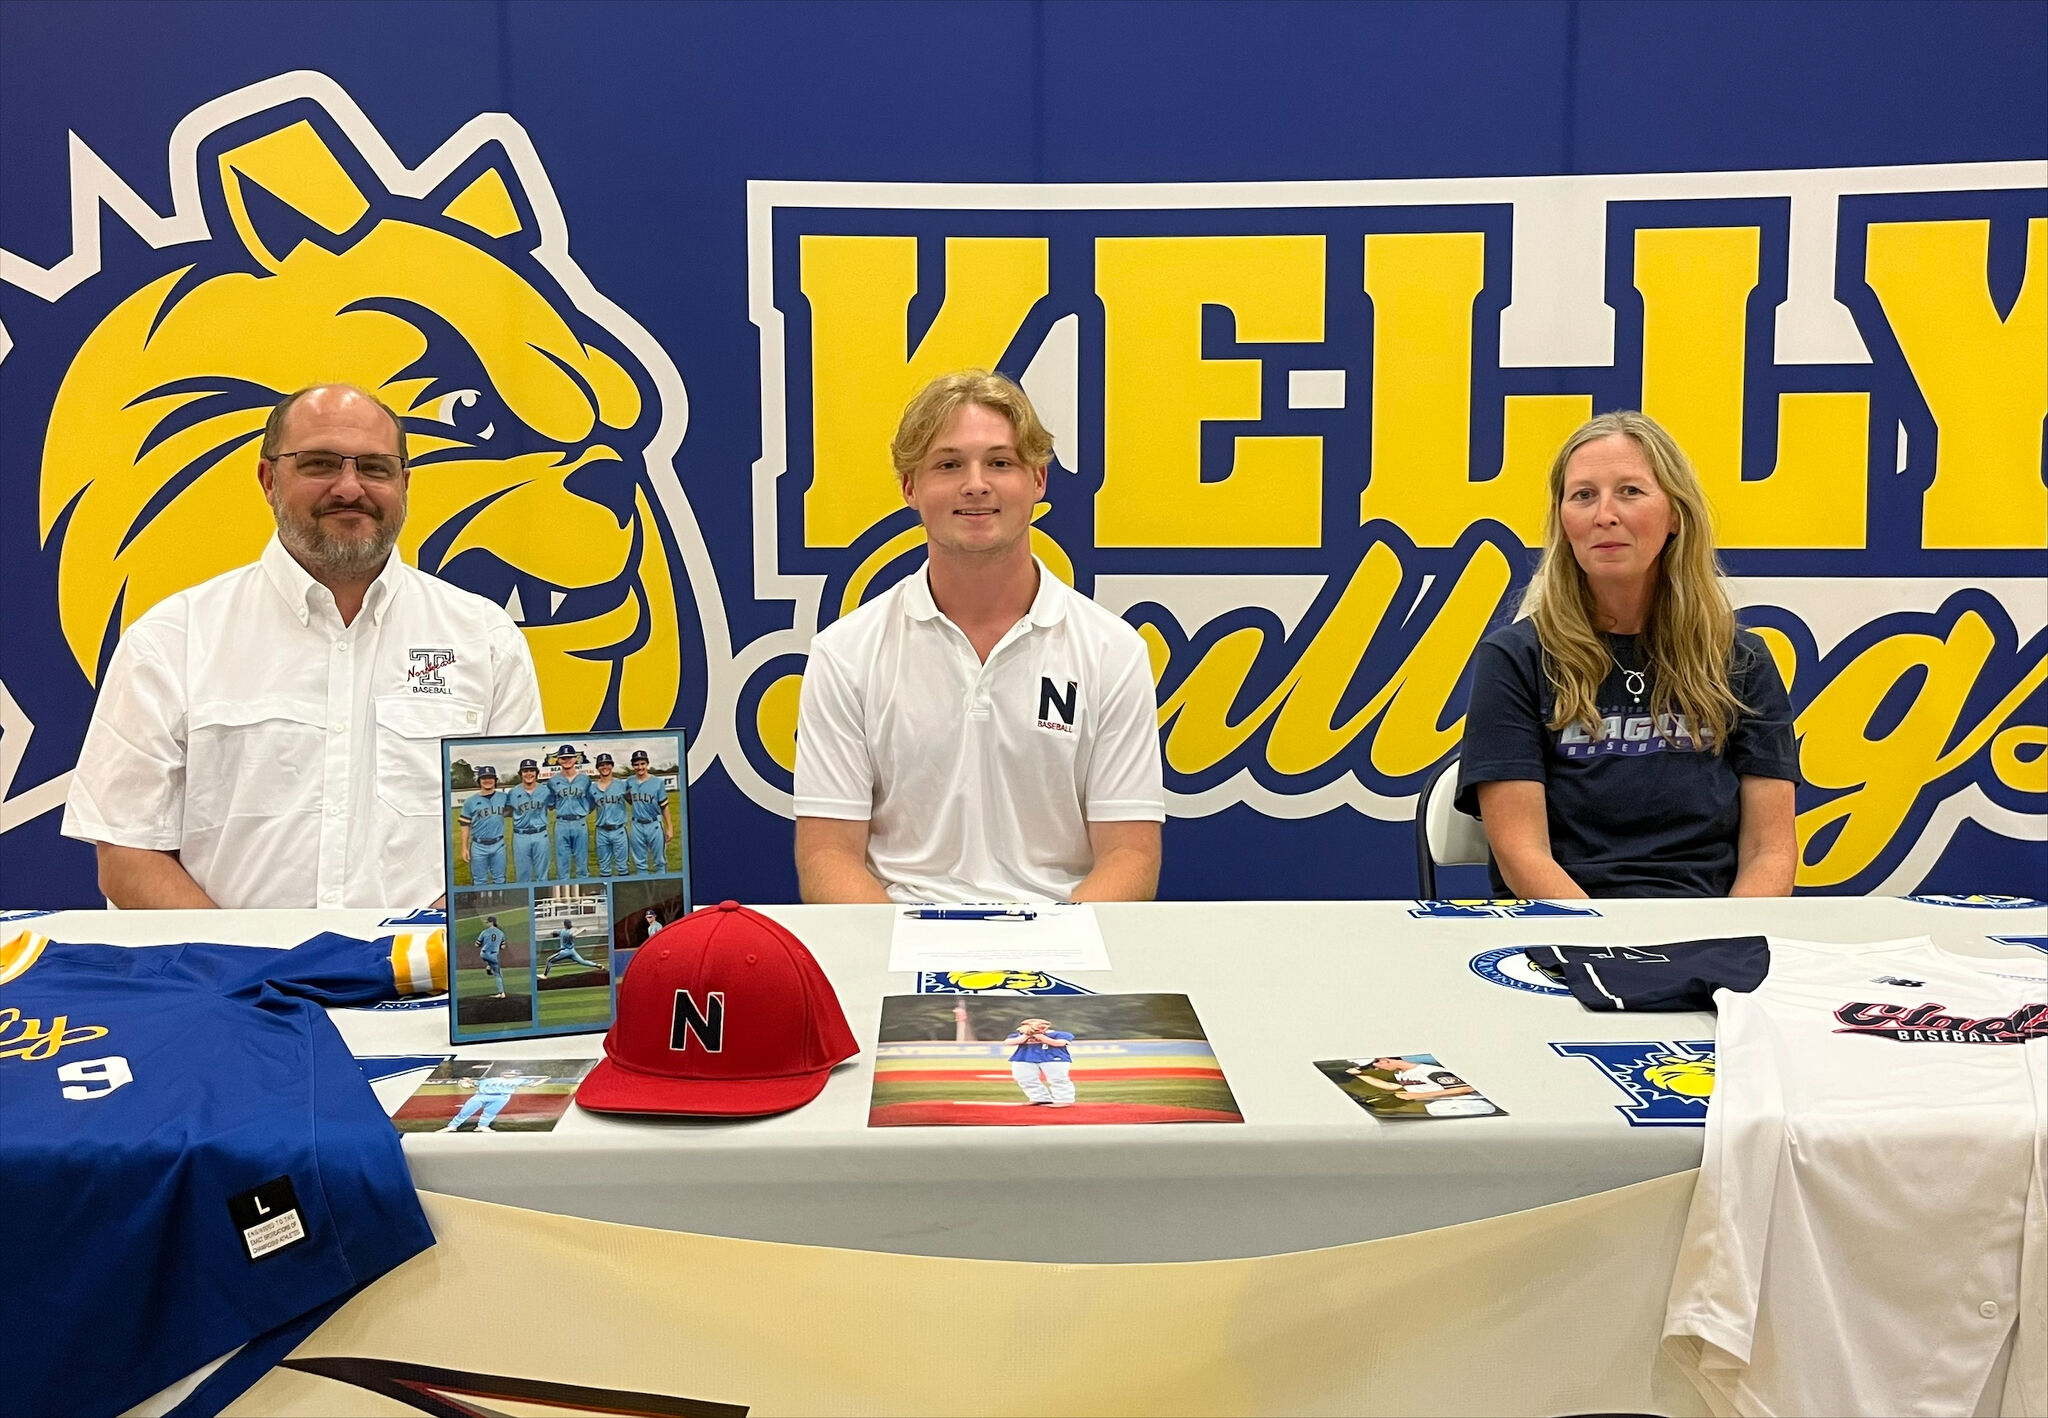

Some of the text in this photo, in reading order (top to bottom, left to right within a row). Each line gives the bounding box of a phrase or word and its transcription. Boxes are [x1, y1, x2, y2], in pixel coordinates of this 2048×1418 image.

[800, 217, 2048, 549] KELLY
[412, 686, 452, 695] BASEBALL
[1039, 676, 1077, 725] N
[1037, 720, 1072, 733] BASEBALL
[670, 989, 724, 1053] N
[1897, 1030, 2004, 1043] BASEBALL
[57, 1056, 134, 1100] 9
[254, 1196, 270, 1215] L
